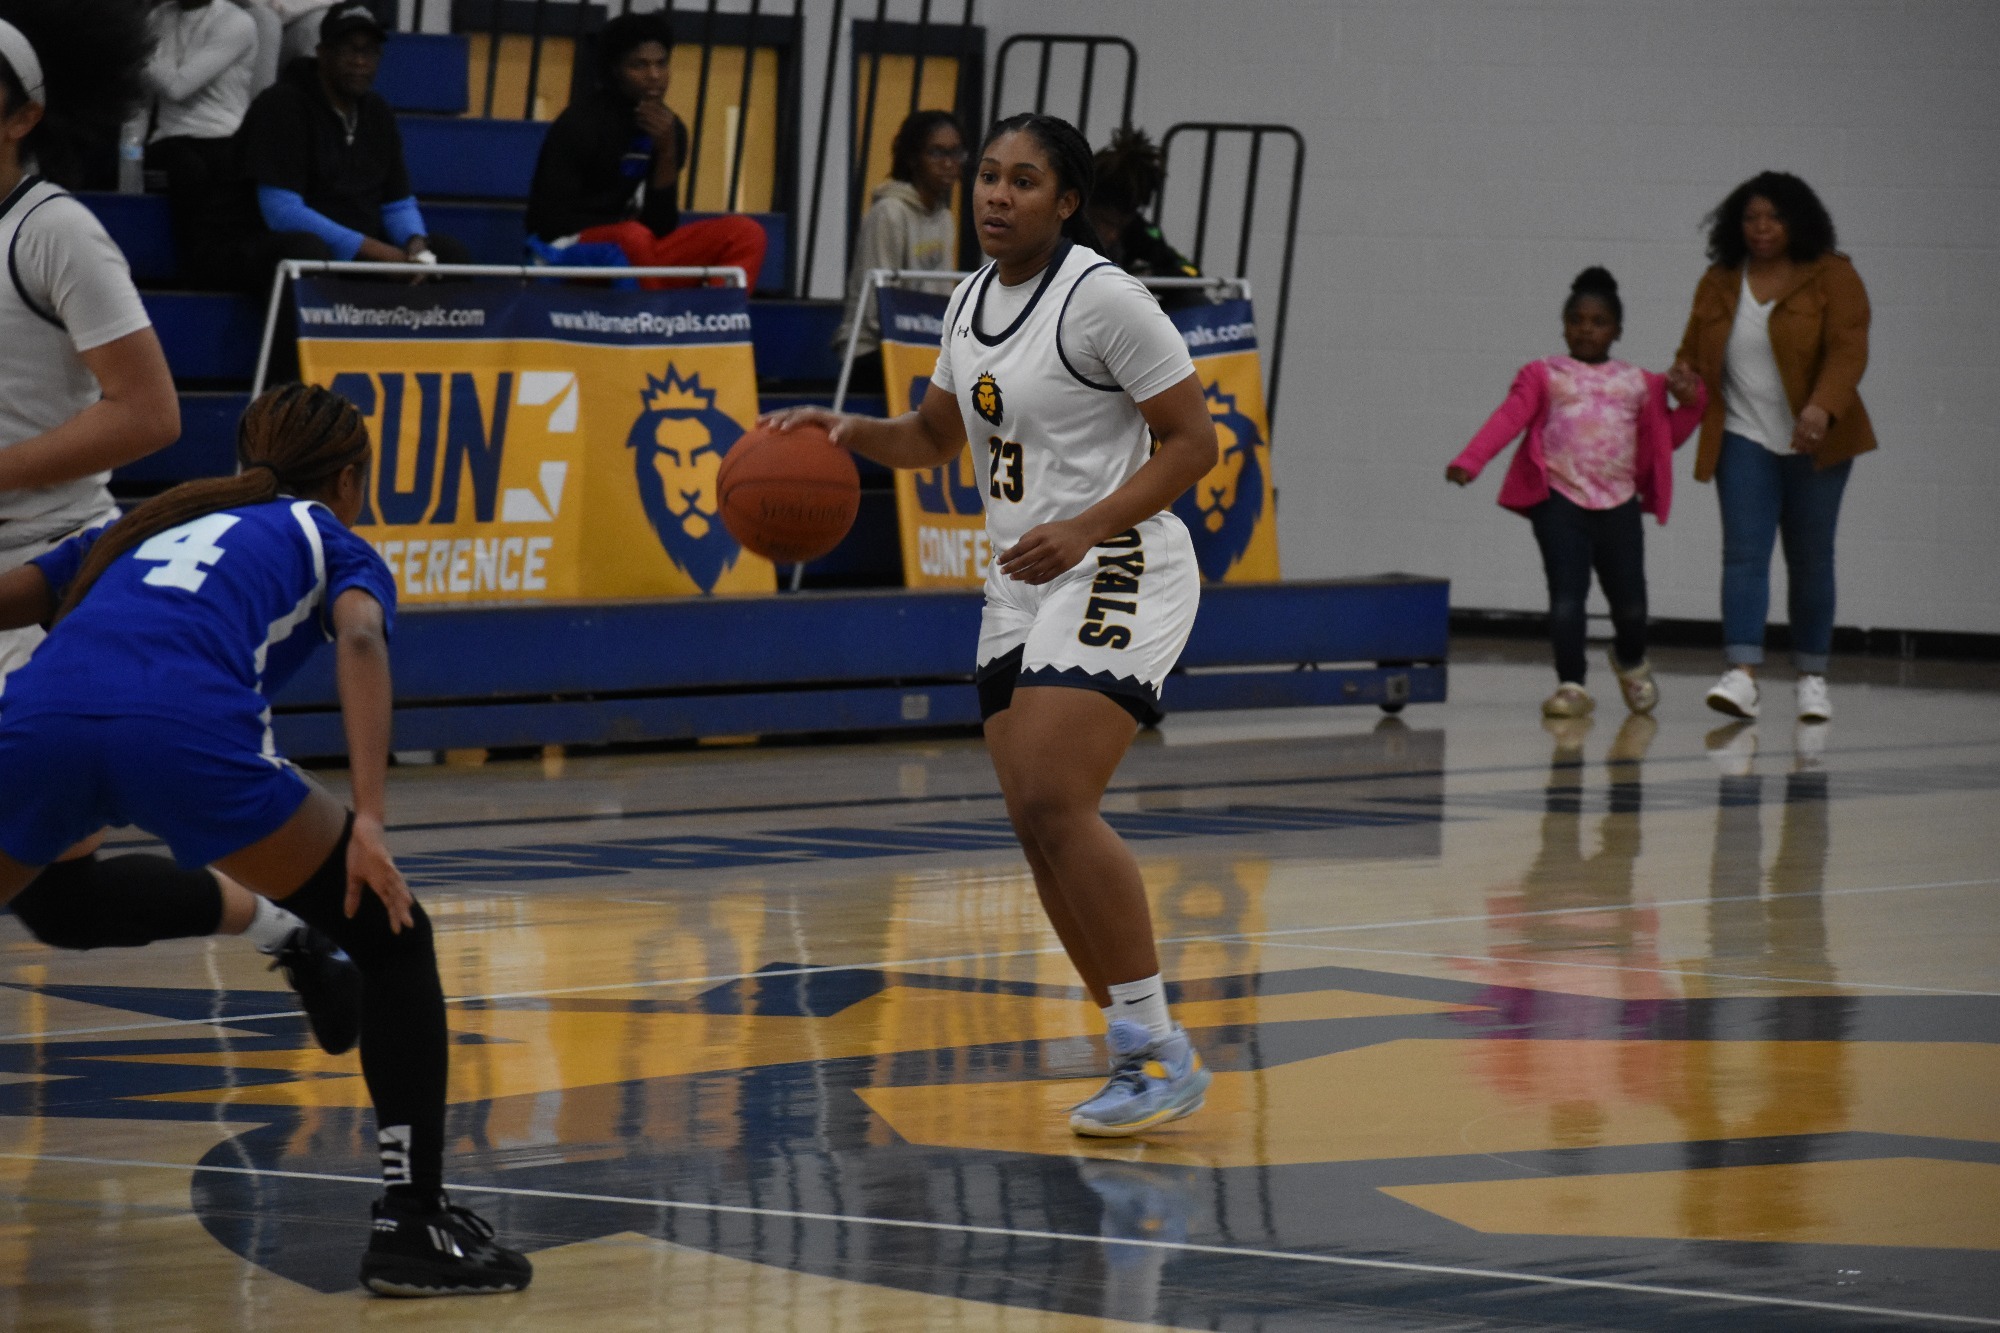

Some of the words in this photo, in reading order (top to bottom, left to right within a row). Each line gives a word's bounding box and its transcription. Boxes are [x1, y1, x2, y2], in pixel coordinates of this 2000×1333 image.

[299, 304, 484, 330] www.WarnerRoyals.com
[549, 310, 751, 337] www.WarnerRoyals.com
[989, 435, 1025, 504] 23
[132, 512, 242, 594] 4
[375, 536, 554, 595] FERENCE
